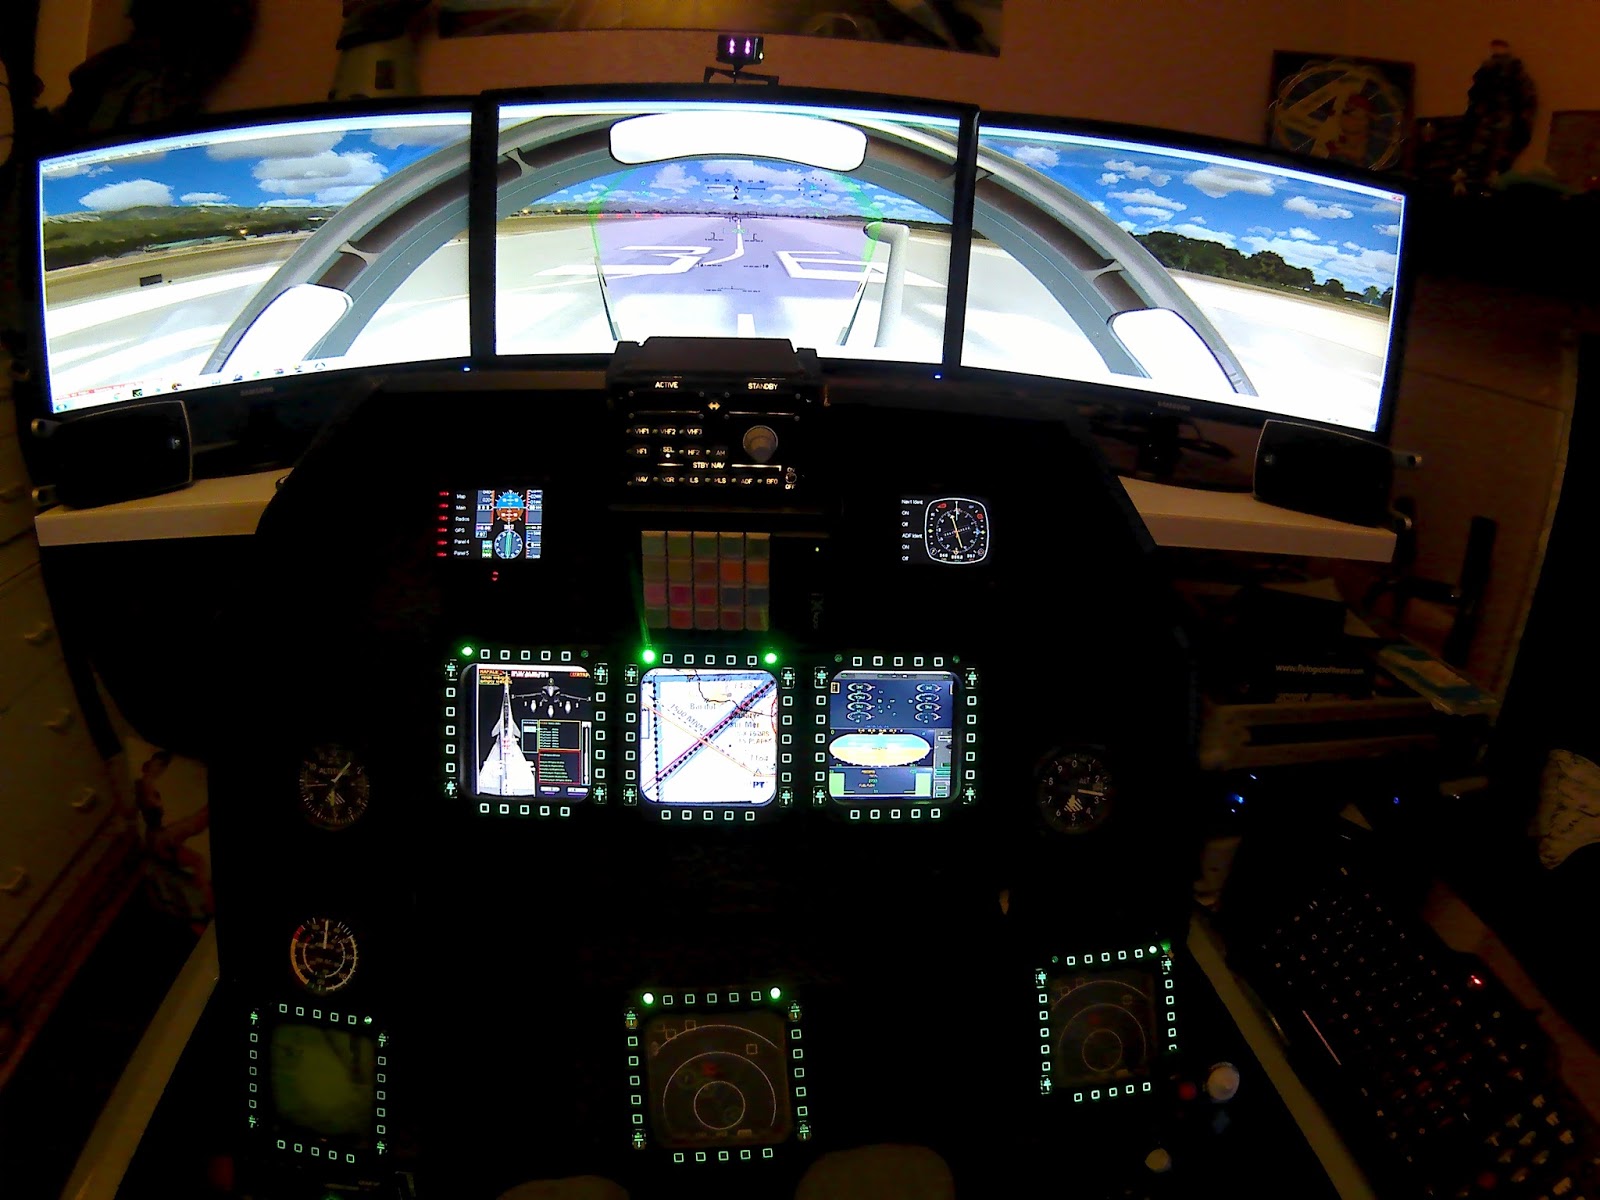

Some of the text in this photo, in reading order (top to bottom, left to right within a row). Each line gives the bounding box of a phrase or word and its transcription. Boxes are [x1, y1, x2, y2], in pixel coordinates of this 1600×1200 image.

[654, 381, 679, 389] ACTIVE
[748, 382, 778, 391] STANDBY
[692, 461, 709, 469] STBY
